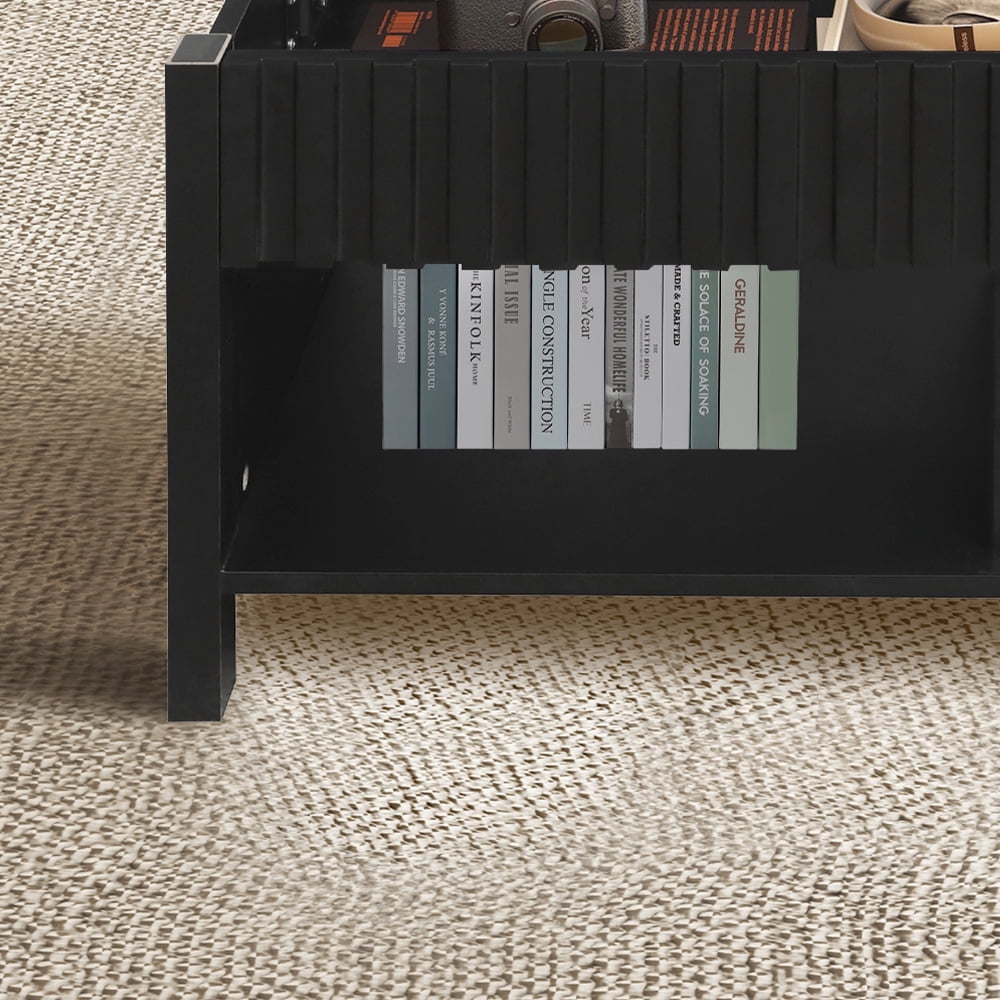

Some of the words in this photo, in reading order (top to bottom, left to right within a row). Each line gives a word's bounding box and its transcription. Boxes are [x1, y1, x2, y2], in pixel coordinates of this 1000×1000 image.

[398, 276, 406, 314] EDWARD
[504, 291, 518, 325] ISSUE
[613, 285, 627, 343] WONDERFUL
[699, 284, 709, 332] SOLACE
[734, 278, 746, 354] GERALDINE
[397, 315, 406, 364] SNOWDEN
[427, 317, 435, 325] &
[470, 281, 482, 363] KINFOLK
[581, 307, 594, 340] Year
[673, 303, 681, 346] CRAFTED
[427, 329, 435, 367] RASMUS
[699, 337, 709, 353] OF
[427, 367, 435, 391] JUUL
[541, 314, 555, 434] CONSTRUCTION
[612, 347, 626, 393] HOMELIFE
[698, 359, 709, 415] SOAKING
[583, 402, 591, 427] TIME
